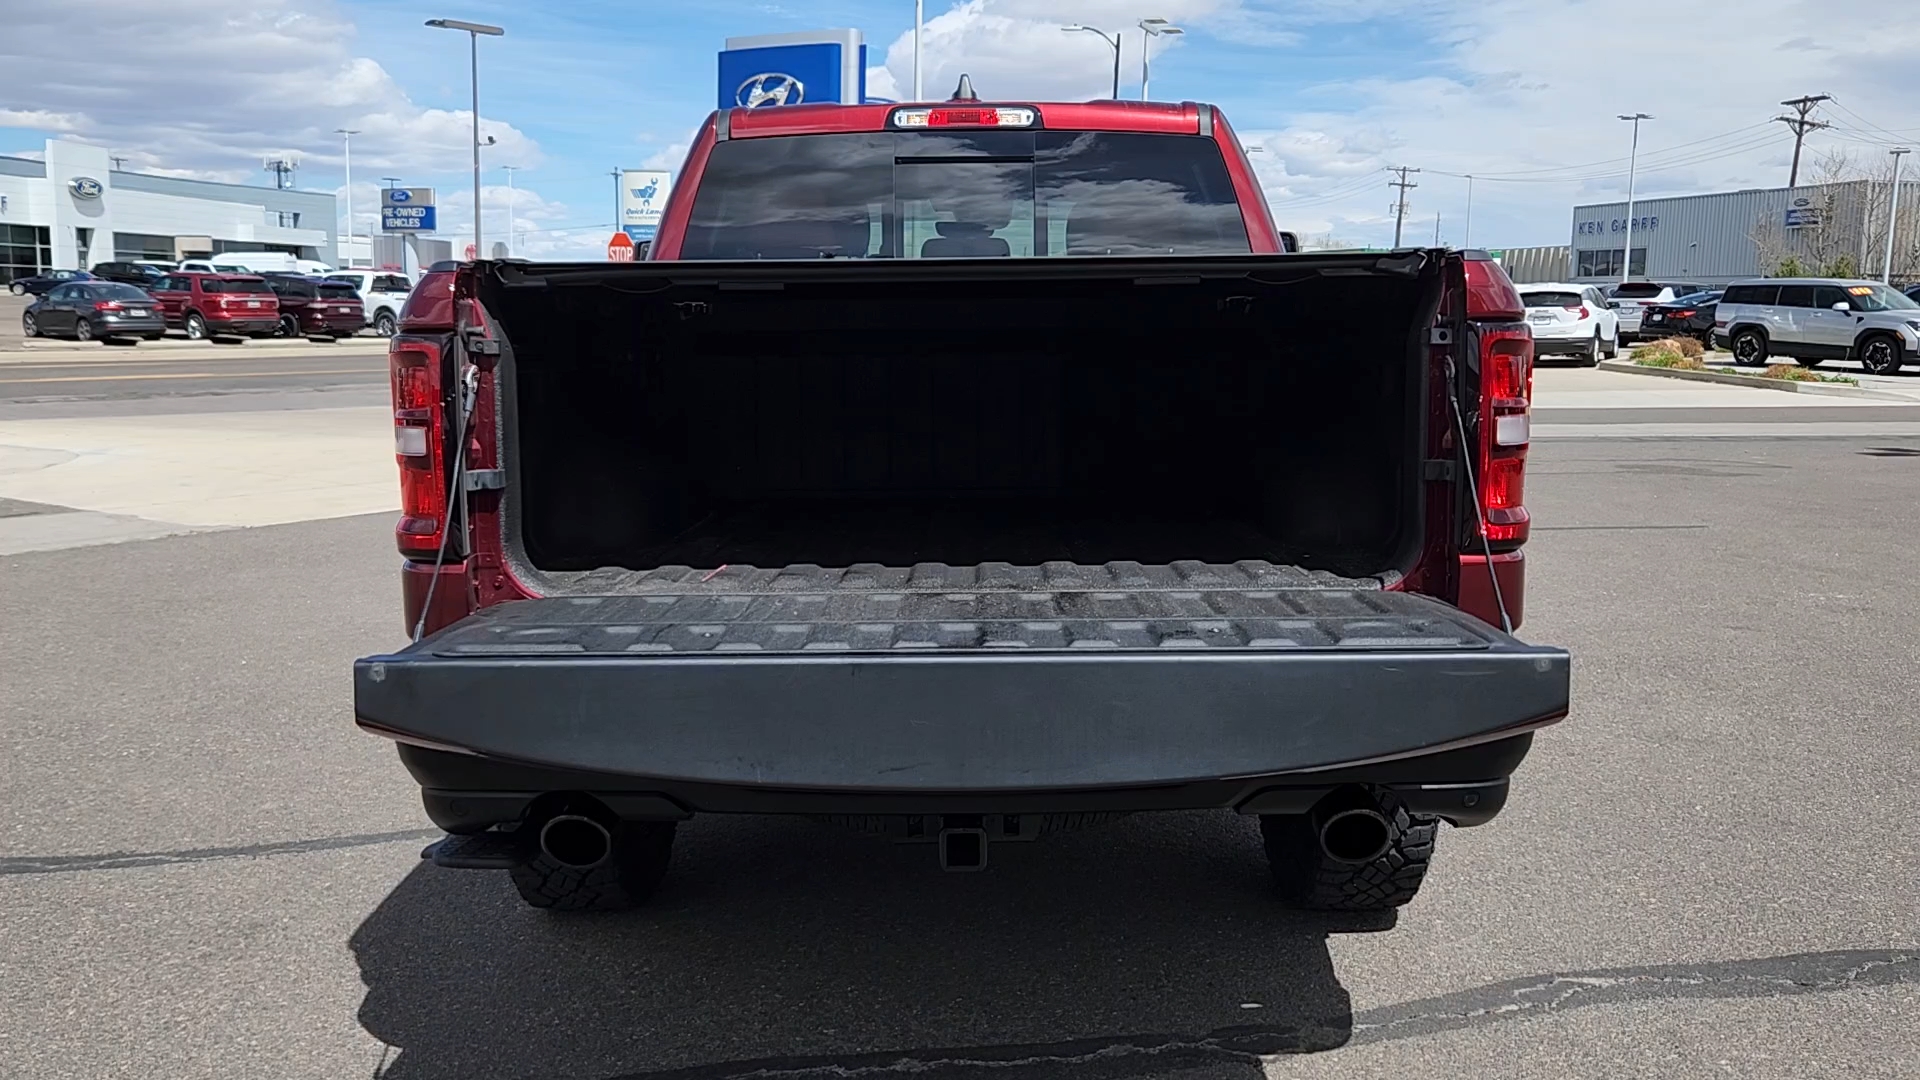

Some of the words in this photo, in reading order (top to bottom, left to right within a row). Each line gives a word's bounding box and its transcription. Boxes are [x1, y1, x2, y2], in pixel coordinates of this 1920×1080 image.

[392, 191, 407, 200] Ford
[383, 207, 426, 217] PRE-OWNED
[385, 218, 420, 227] VEHICLES
[1579, 221, 1603, 234] KEN
[1611, 216, 1659, 232] GARFF
[609, 246, 633, 261] STOP
